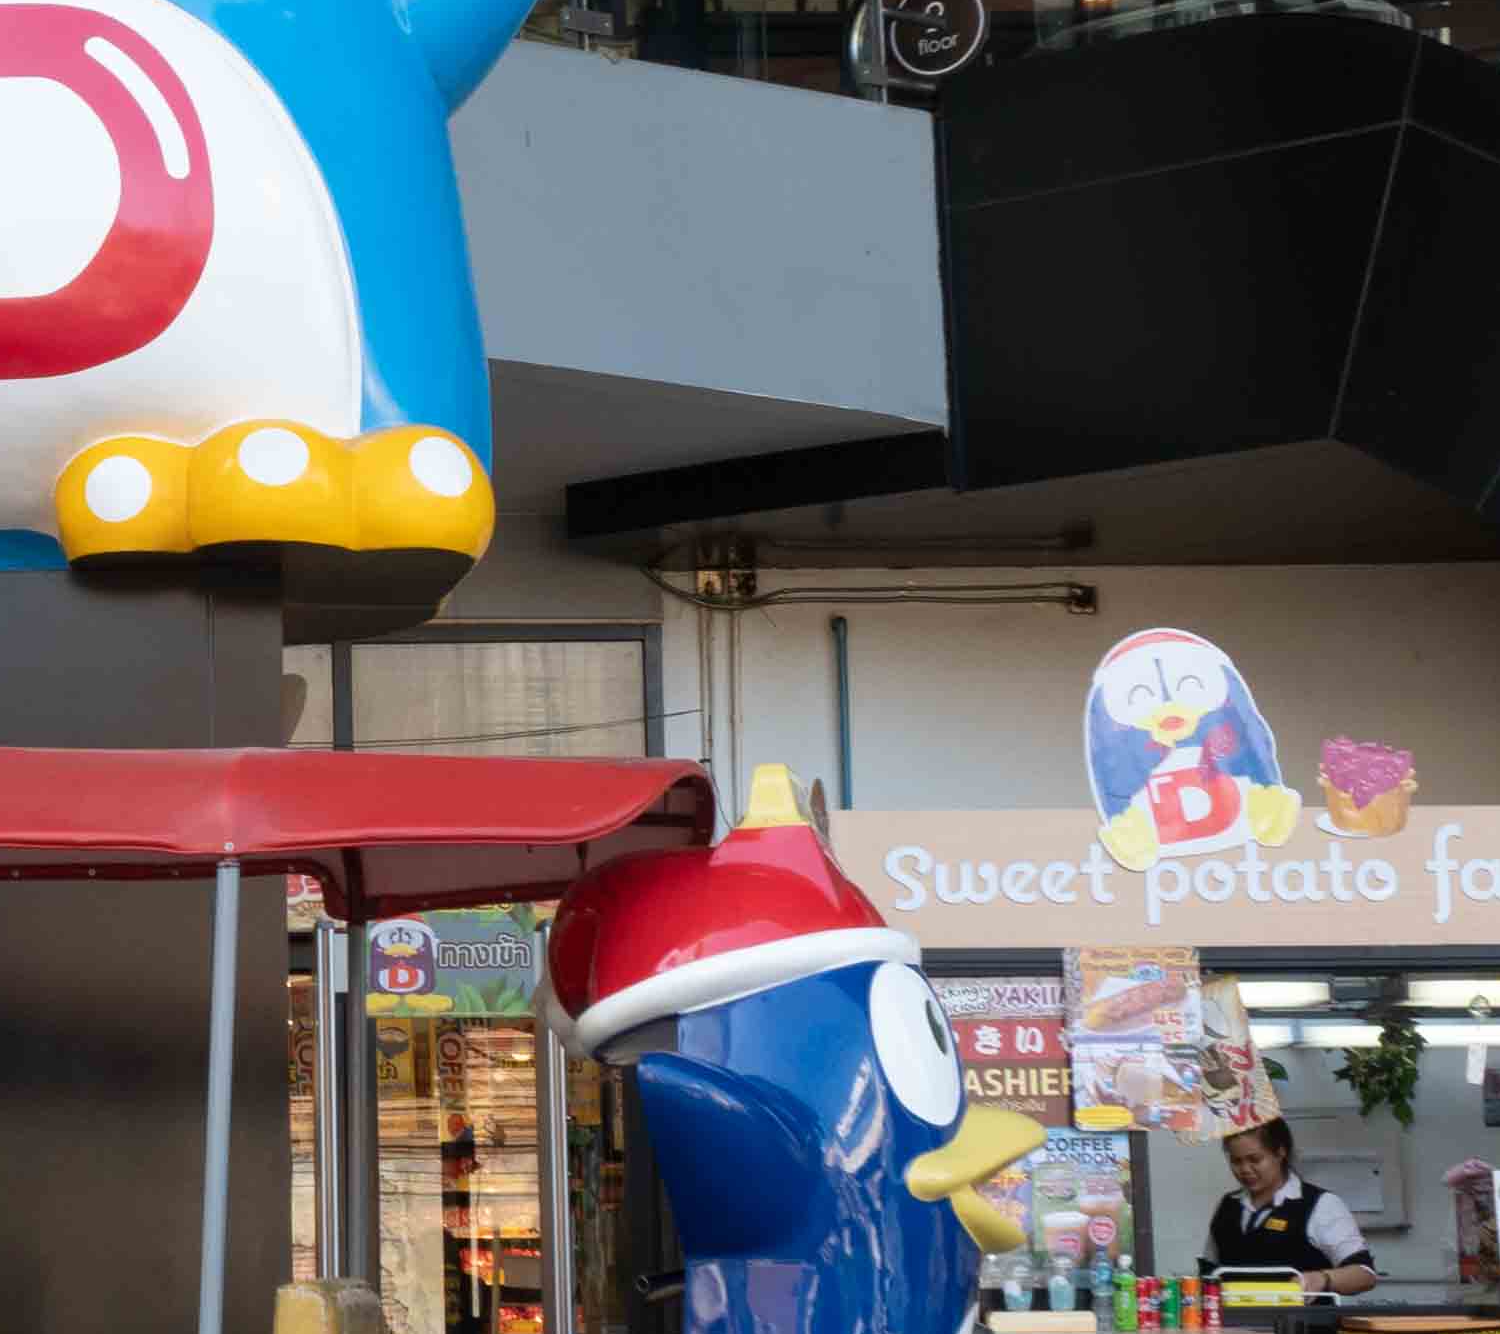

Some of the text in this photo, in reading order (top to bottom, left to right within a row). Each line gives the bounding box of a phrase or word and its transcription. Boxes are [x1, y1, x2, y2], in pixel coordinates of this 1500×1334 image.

[884, 843, 1115, 912] Sweet
[1145, 835, 1399, 926] potato
[439, 934, 532, 969] ทางเข้า
[1045, 1137, 1113, 1152] COFFEE
